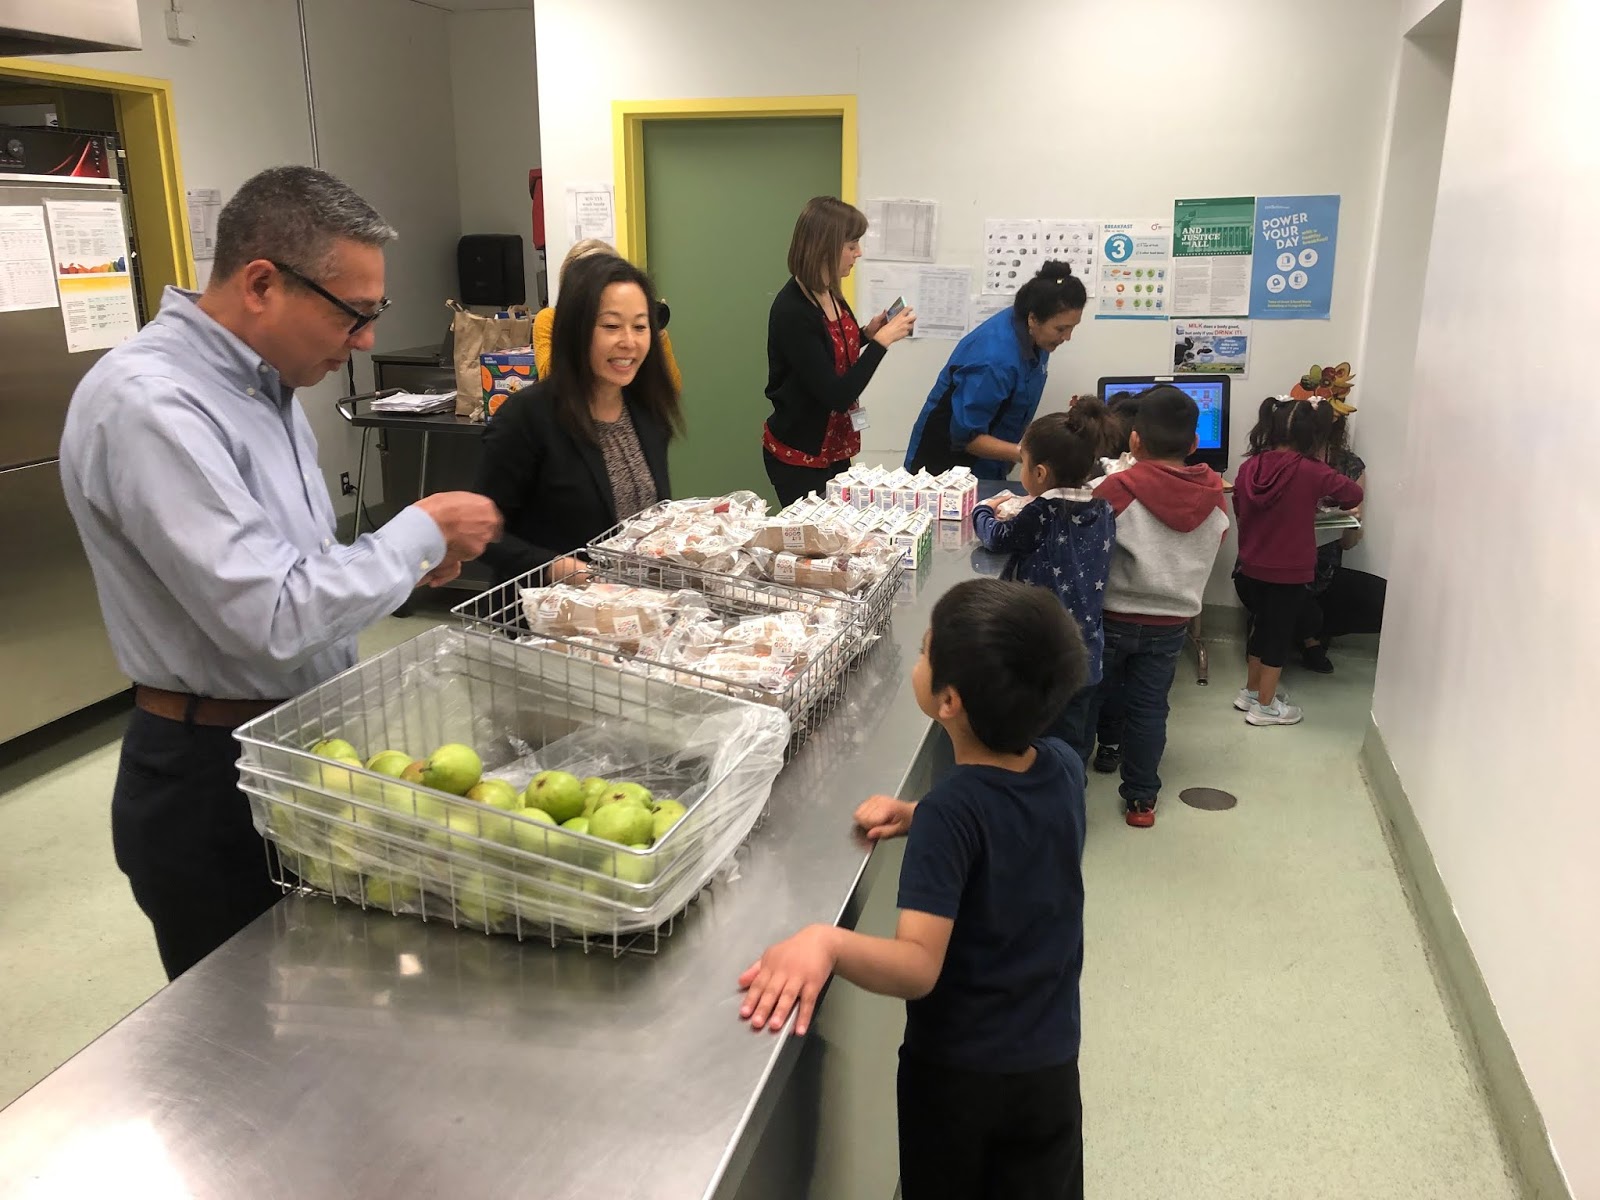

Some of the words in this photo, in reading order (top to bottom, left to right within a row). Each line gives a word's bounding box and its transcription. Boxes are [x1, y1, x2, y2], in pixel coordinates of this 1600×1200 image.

[1262, 212, 1308, 230] POWER
[1181, 233, 1221, 241] JUSTICE
[1182, 227, 1202, 235] AND
[1262, 225, 1299, 241] YOUR
[1111, 240, 1126, 259] 3
[1191, 240, 1209, 248] ALL
[1276, 236, 1299, 250] DAY
